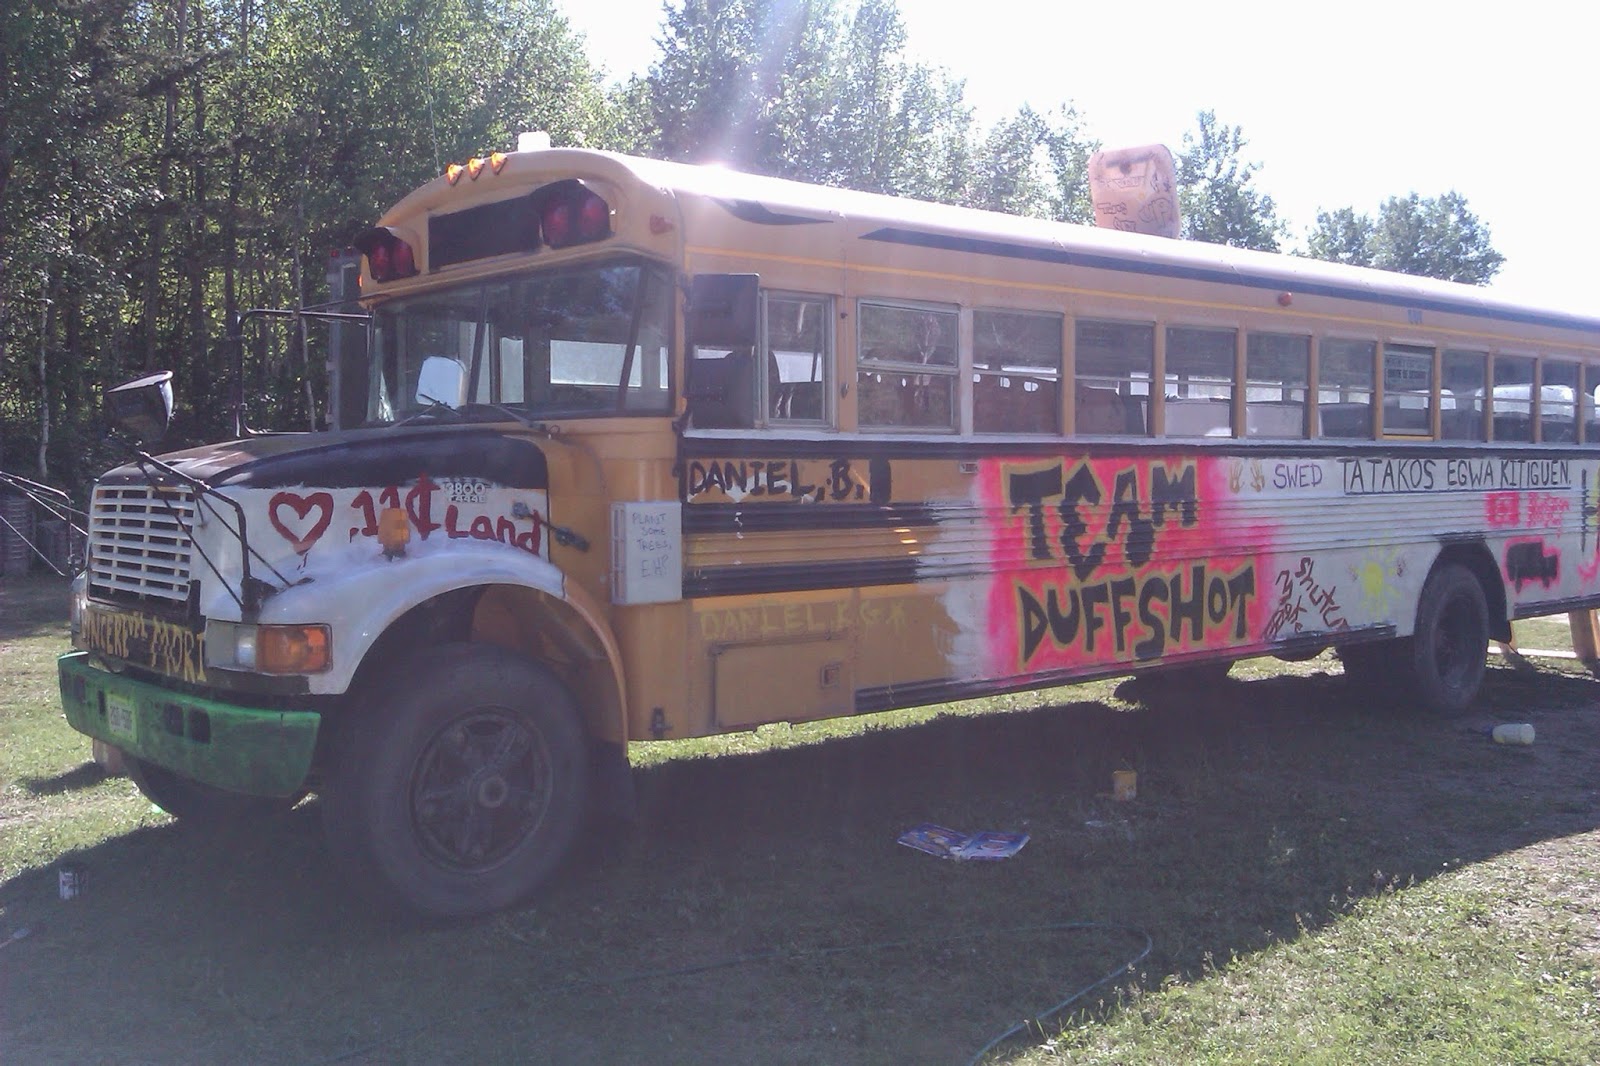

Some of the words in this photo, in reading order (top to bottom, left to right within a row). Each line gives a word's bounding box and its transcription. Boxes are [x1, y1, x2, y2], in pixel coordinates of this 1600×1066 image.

[1004, 457, 1198, 582] TEAM
[1447, 459, 1494, 488] EGWA
[1014, 561, 1255, 667] DUFFSHOT
